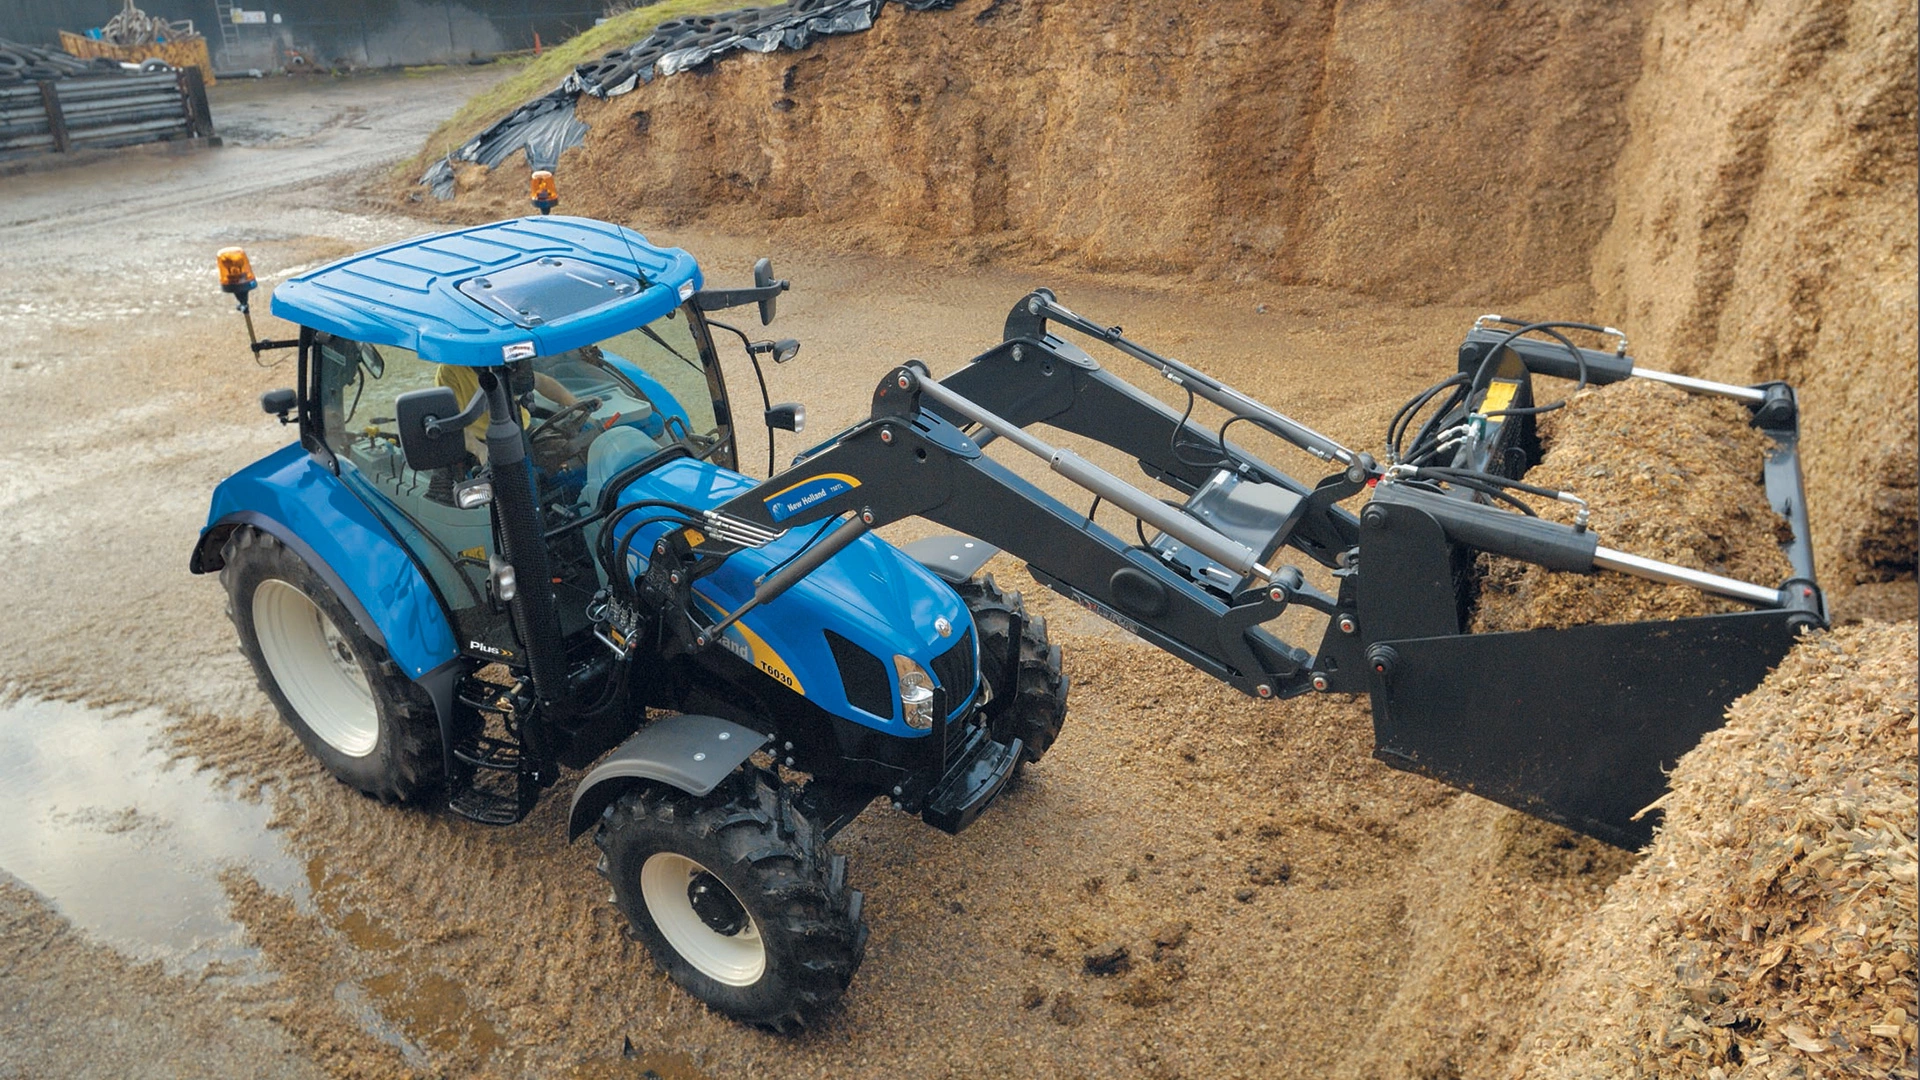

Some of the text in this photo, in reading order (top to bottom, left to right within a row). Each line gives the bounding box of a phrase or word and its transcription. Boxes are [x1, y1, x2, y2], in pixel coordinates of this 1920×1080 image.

[787, 488, 827, 512] New Holland
[470, 640, 499, 655] Plus
[760, 660, 793, 687] T6030
